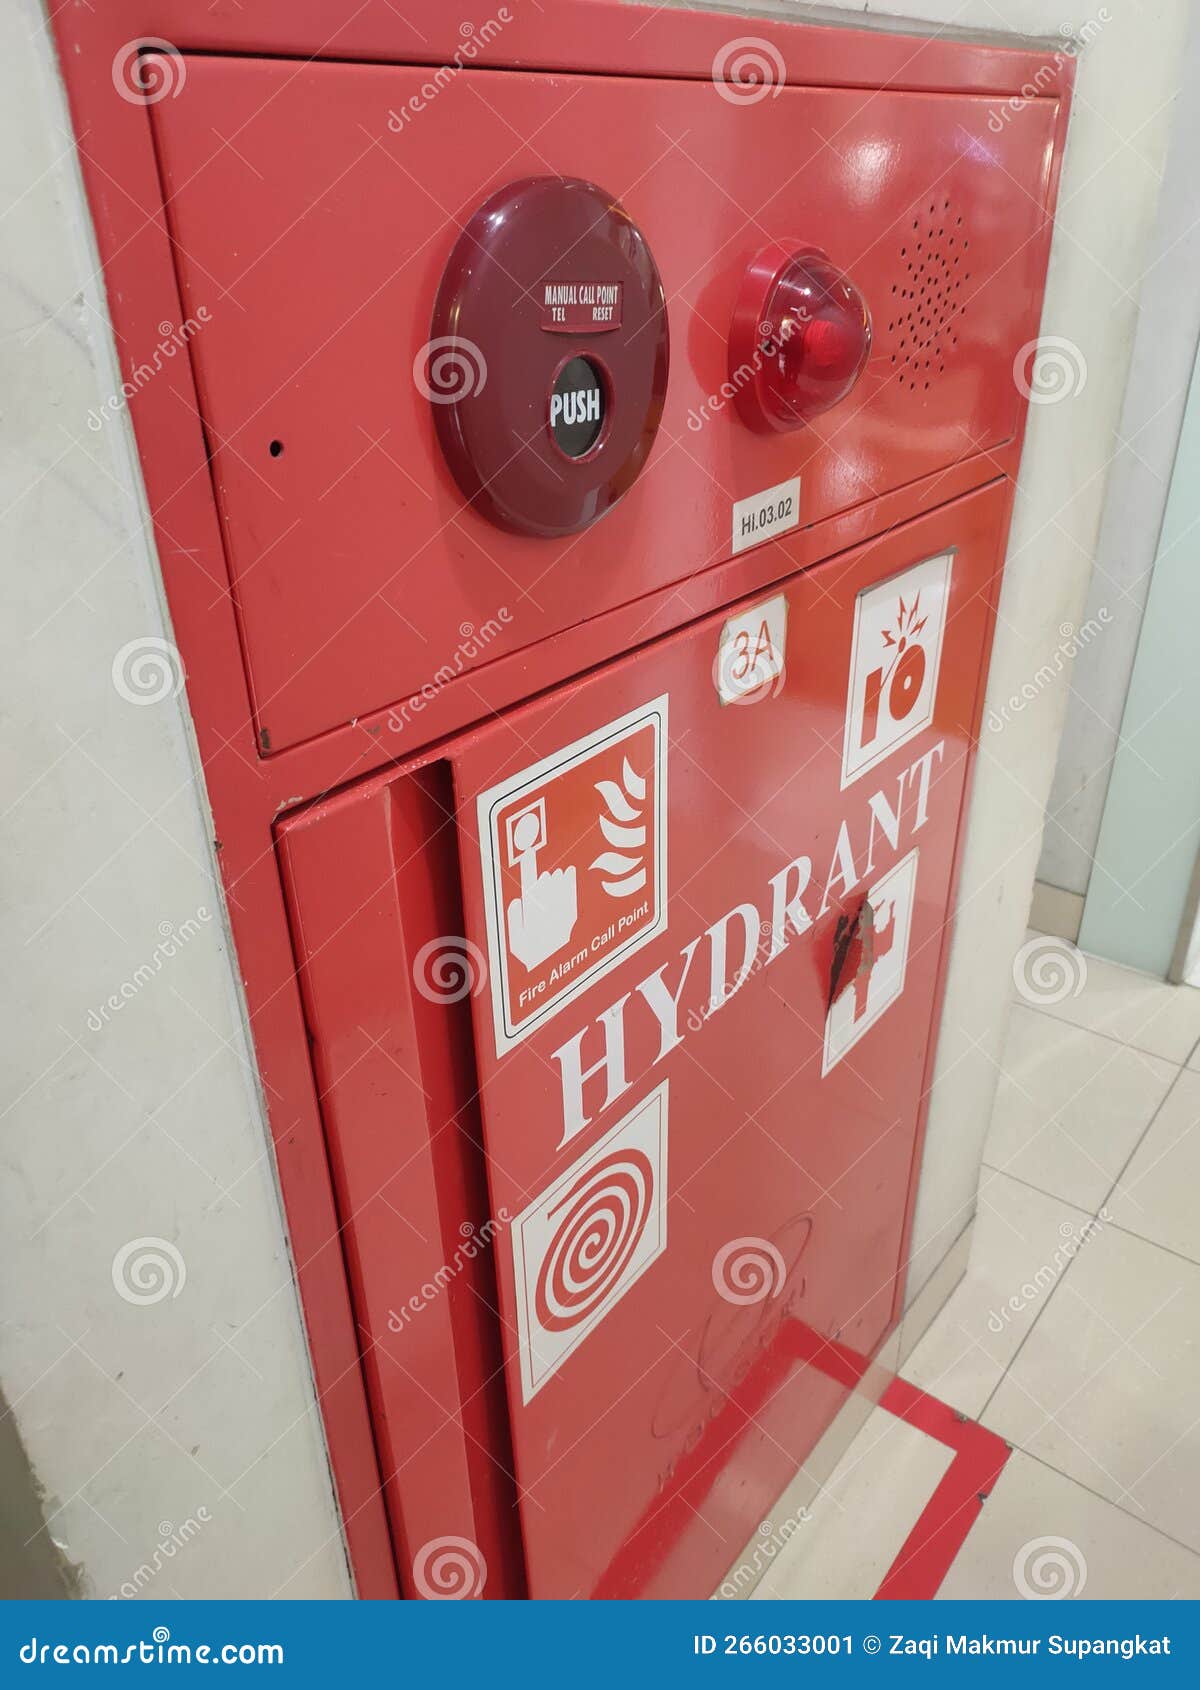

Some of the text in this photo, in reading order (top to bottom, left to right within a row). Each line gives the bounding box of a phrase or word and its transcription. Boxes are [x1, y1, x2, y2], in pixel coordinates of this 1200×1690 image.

[545, 285, 618, 305] MANUAL CALL POINT
[552, 306, 613, 322] TEL RESET
[550, 388, 600, 427] PUSH
[732, 619, 774, 680] 3A
[519, 901, 649, 1008] Fire Alarm Call Point
[550, 740, 945, 1152] HYDRANT
